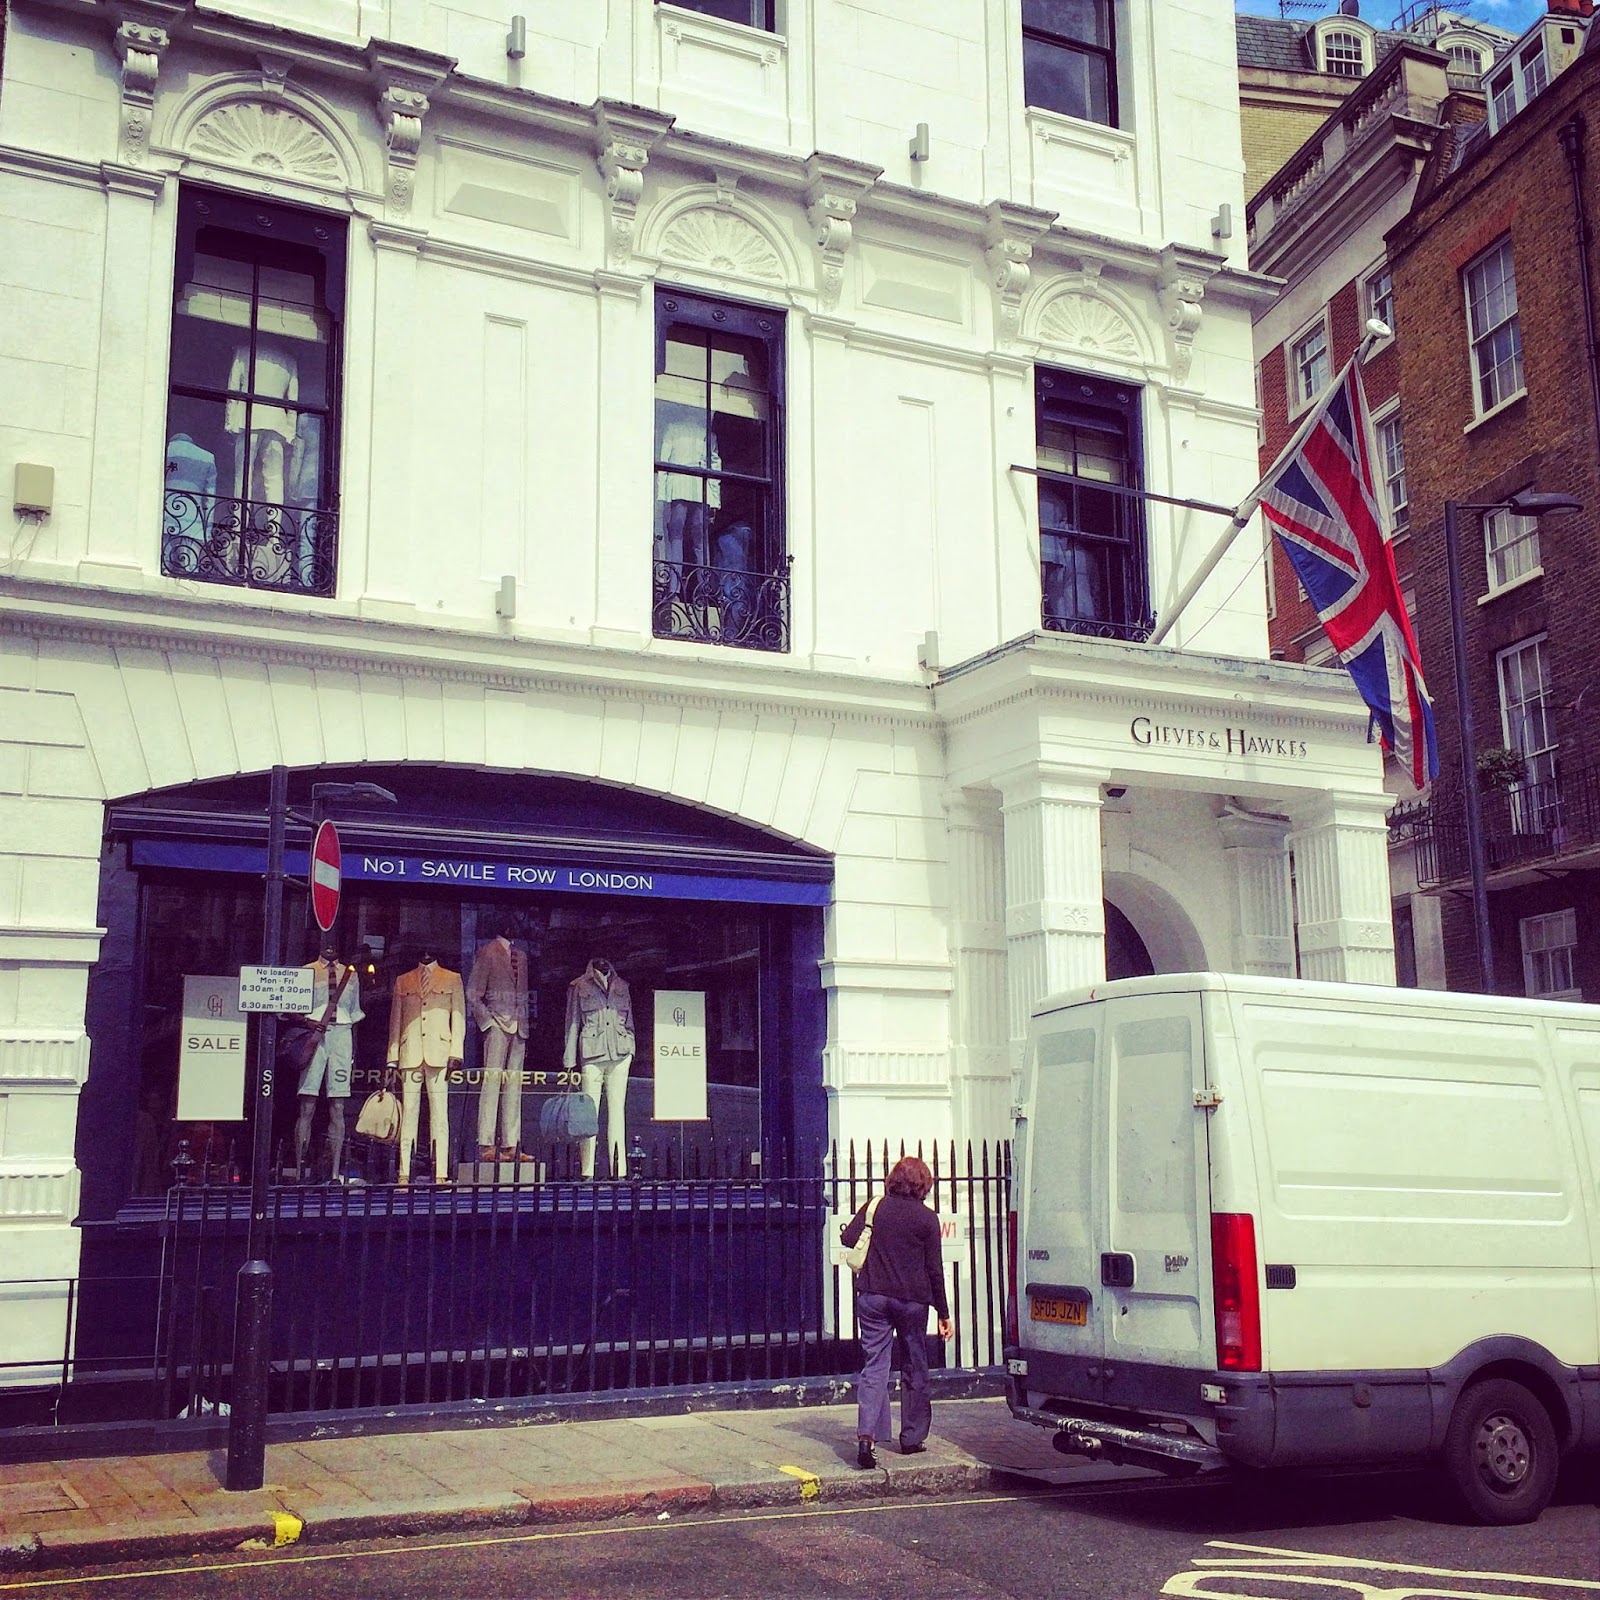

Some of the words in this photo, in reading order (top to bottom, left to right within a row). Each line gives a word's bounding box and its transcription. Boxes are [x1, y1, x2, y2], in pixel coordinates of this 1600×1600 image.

[1130, 716, 1205, 748] GIEVES
[1225, 727, 1307, 758] HAWKES
[421, 861, 496, 881] SAVILE
[507, 866, 556, 884] ROW
[568, 871, 653, 890] LONDON
[256, 968, 268, 976] No
[270, 969, 299, 977] loading
[187, 1037, 240, 1050] SALE
[659, 1046, 701, 1057] SALE
[334, 1069, 425, 1084] SPRING
[450, 1069, 547, 1085] SUMMER
[1033, 1300, 1058, 1318] SF05
[1059, 1302, 1081, 1321] JZN
